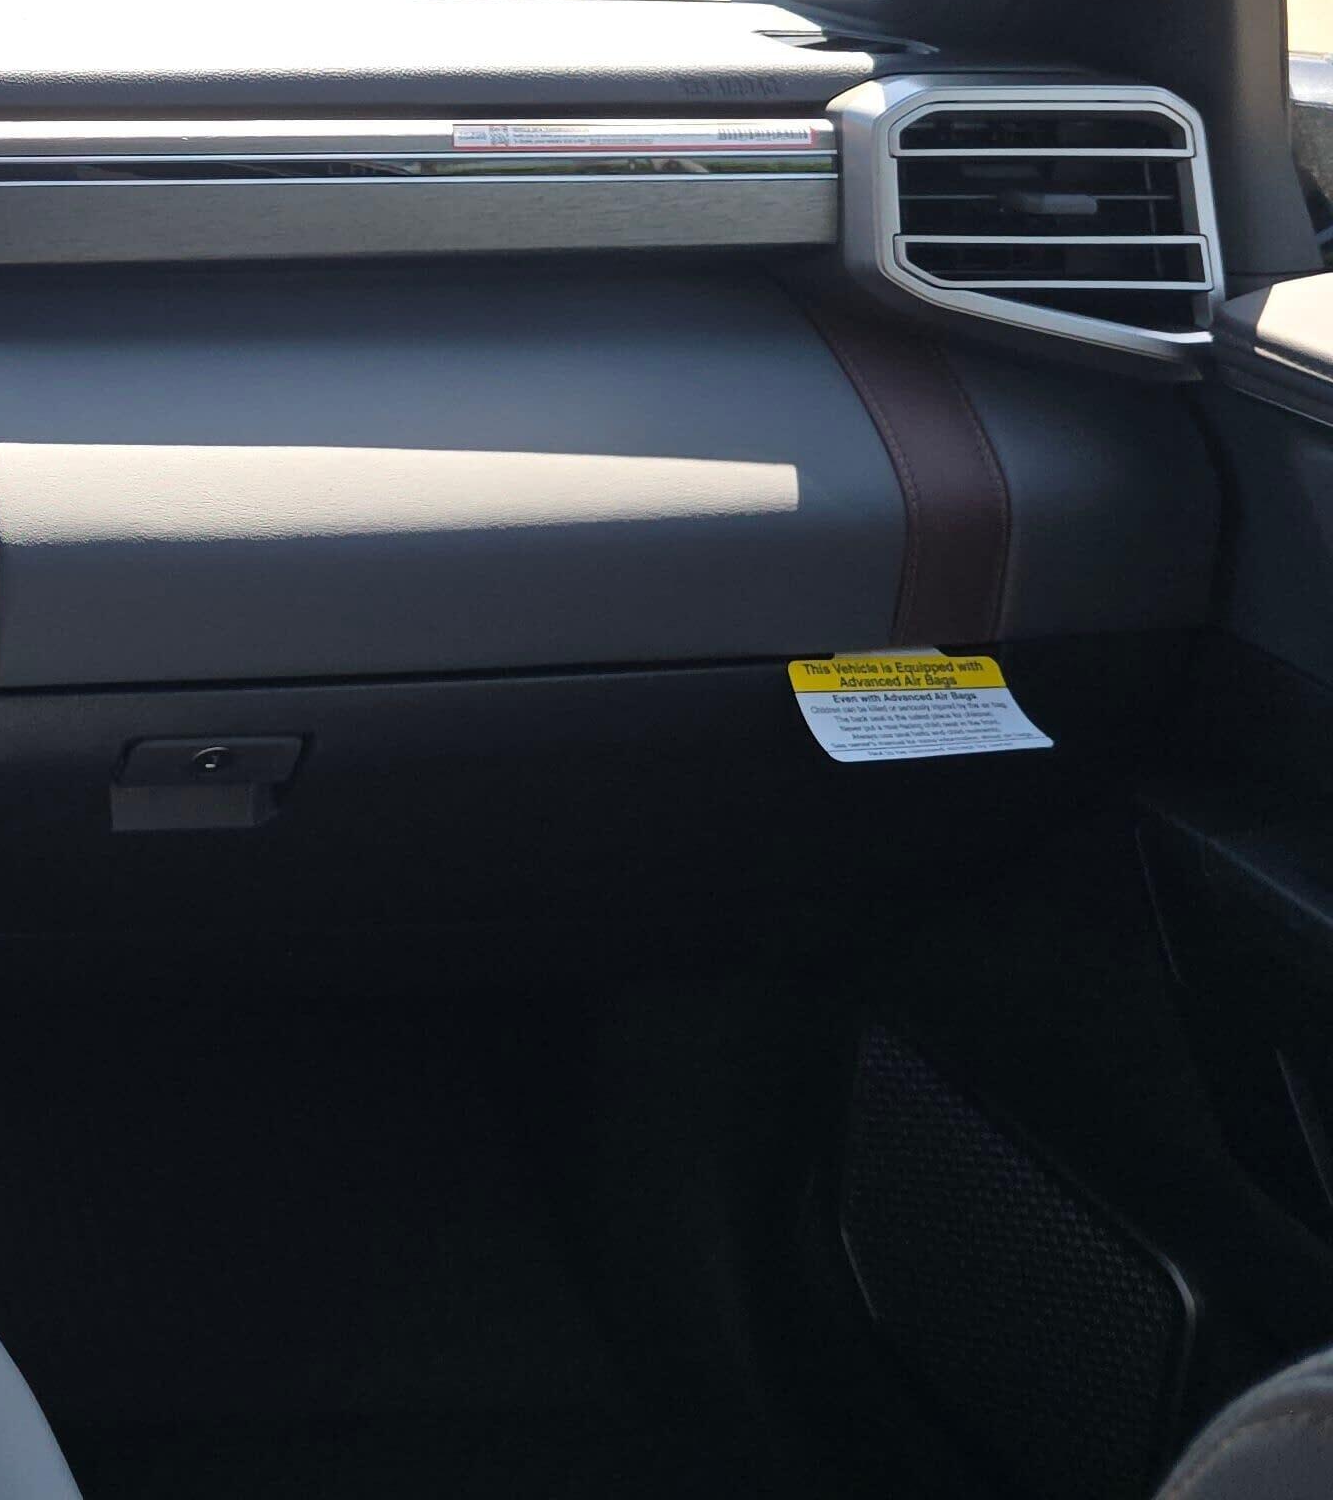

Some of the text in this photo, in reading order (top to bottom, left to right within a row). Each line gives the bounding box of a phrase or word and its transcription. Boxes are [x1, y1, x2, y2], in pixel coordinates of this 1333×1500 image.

[804, 663, 830, 675] This
[833, 663, 879, 674] Vehicle
[895, 660, 954, 675] Equipped
[958, 660, 984, 671] with
[840, 674, 958, 688] Advanced Air Bags
[833, 691, 978, 703] Even with Advanced Air Bags
